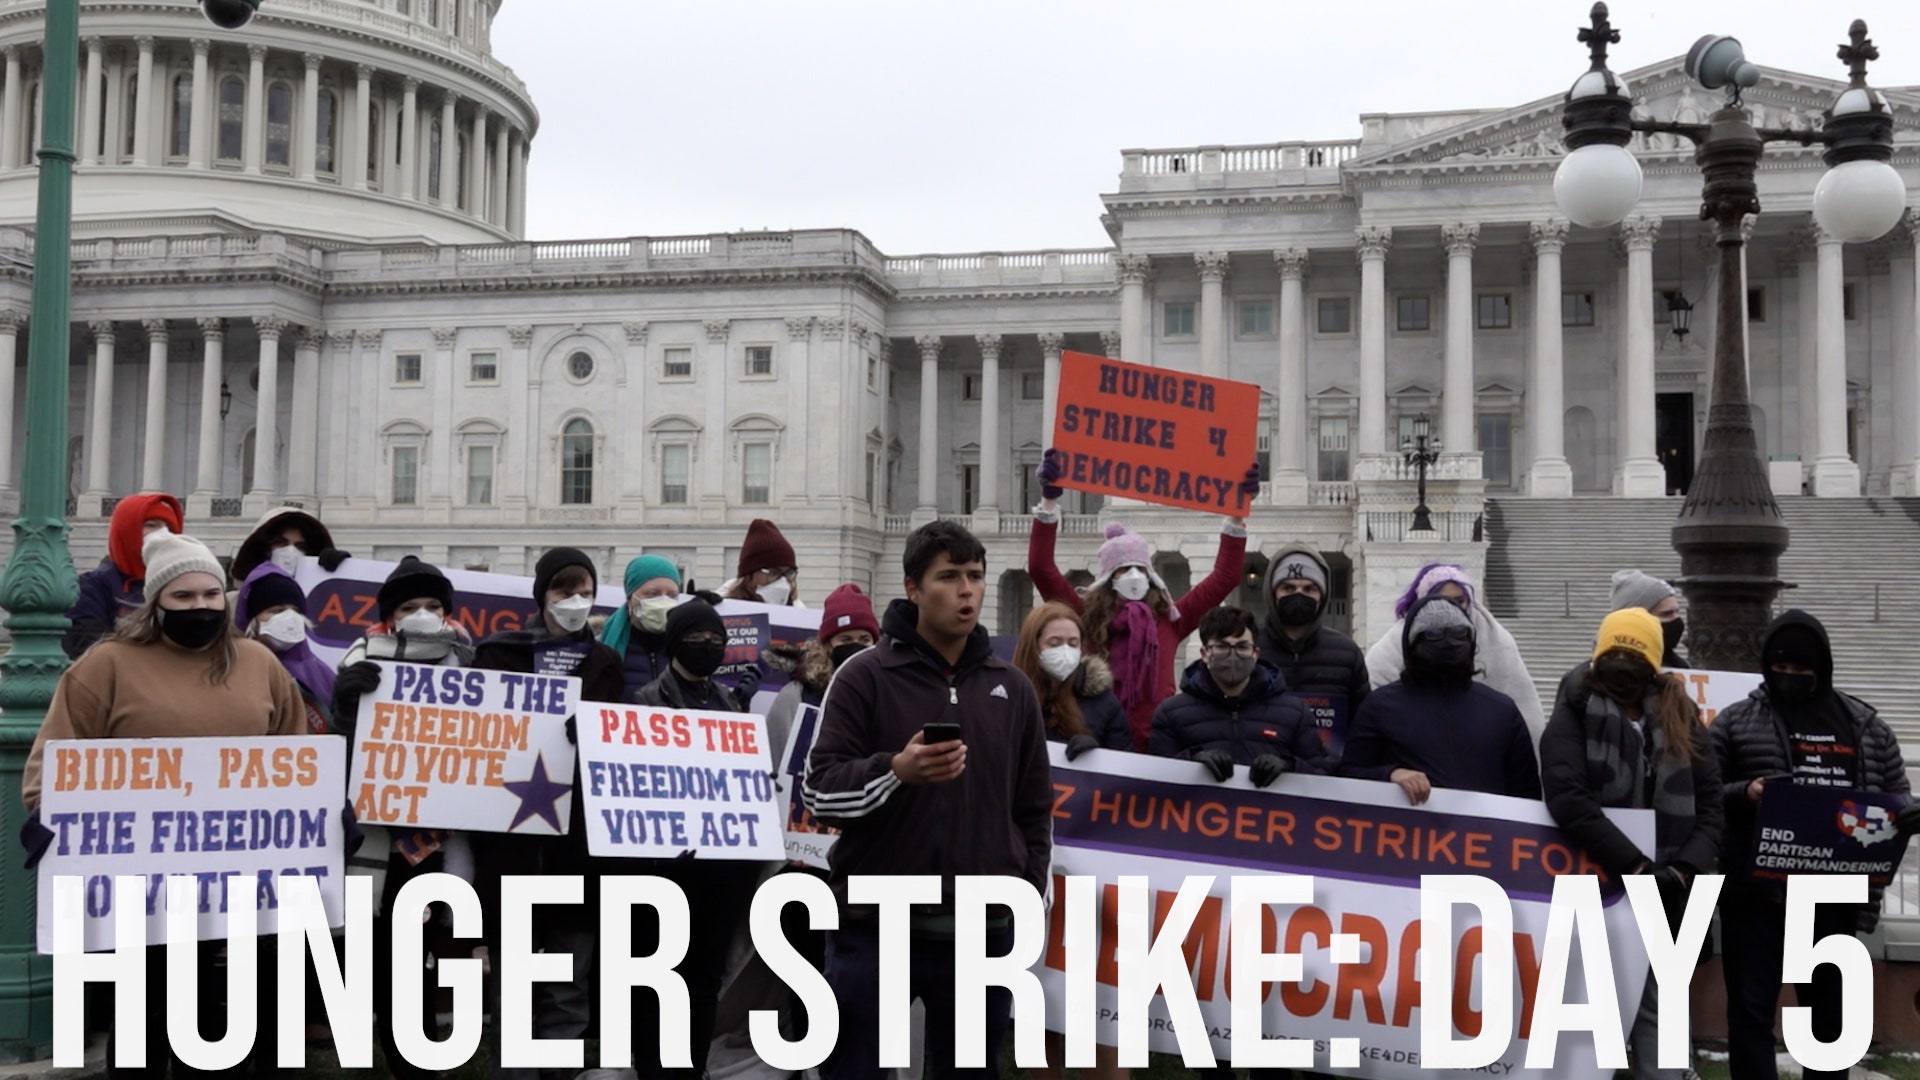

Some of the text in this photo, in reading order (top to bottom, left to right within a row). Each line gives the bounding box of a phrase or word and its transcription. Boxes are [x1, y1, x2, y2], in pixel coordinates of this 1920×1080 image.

[1099, 364, 1215, 412] HUNGER
[1062, 404, 1227, 457] STRIKE 4
[318, 593, 377, 628] AZ
[739, 627, 758, 636] OUR
[746, 637, 758, 645] TO
[393, 665, 568, 715] PASS THE
[370, 702, 531, 751] FREEDOM
[600, 709, 759, 755] PASS THE
[1315, 708, 1336, 718] OUR
[1321, 719, 1334, 728] TO
[54, 747, 318, 797] BIDEN, PASS
[361, 741, 507, 787] TO VOTE
[588, 761, 773, 802] FREEDOM TO
[354, 783, 428, 824] ACT
[50, 807, 328, 856] THE FREEDOM
[601, 808, 760, 847] VOTE ACT
[1089, 788, 1296, 847] HUNGER
[1312, 815, 1493, 868] STRIKE
[1761, 827, 1795, 842] END
[1755, 855, 1892, 873] GERRYMANDERING
[1758, 842, 1834, 858] PARTISAN
